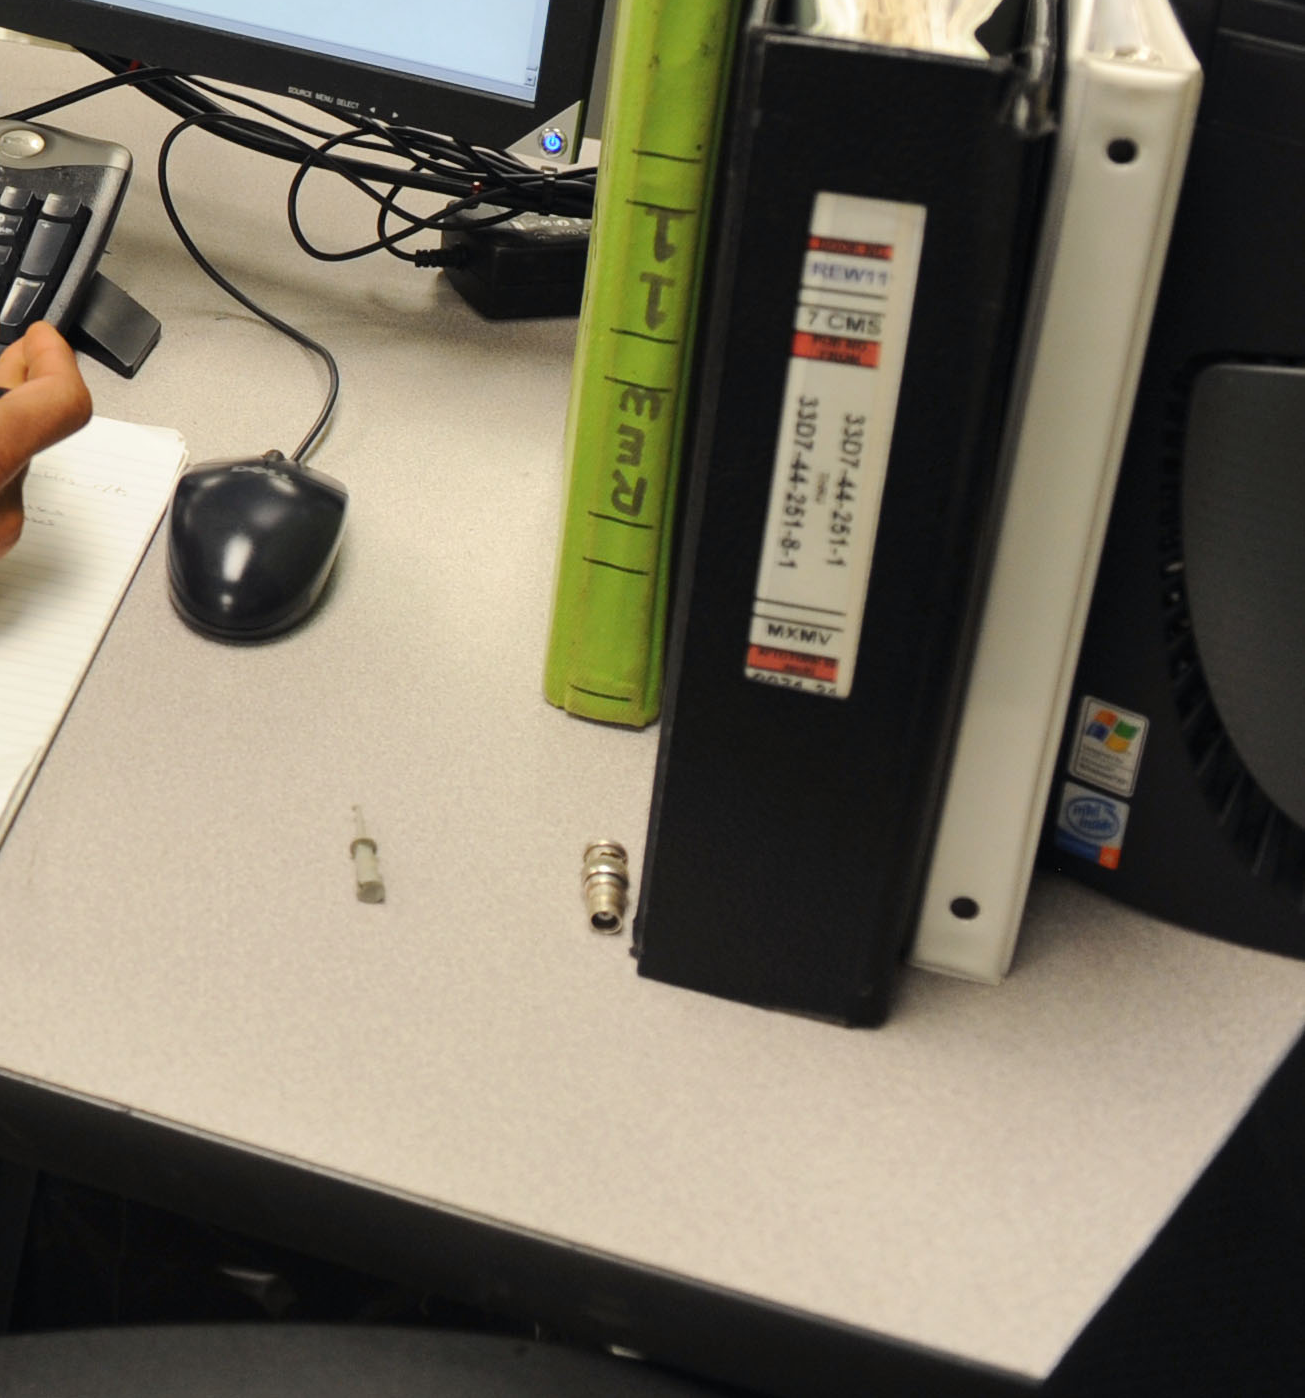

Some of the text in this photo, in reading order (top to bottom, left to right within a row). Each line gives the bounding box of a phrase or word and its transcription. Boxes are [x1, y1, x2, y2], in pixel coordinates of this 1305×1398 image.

[813, 261, 888, 286] REW11
[808, 311, 882, 336] 7 CMS
[766, 622, 834, 646] MXMV
